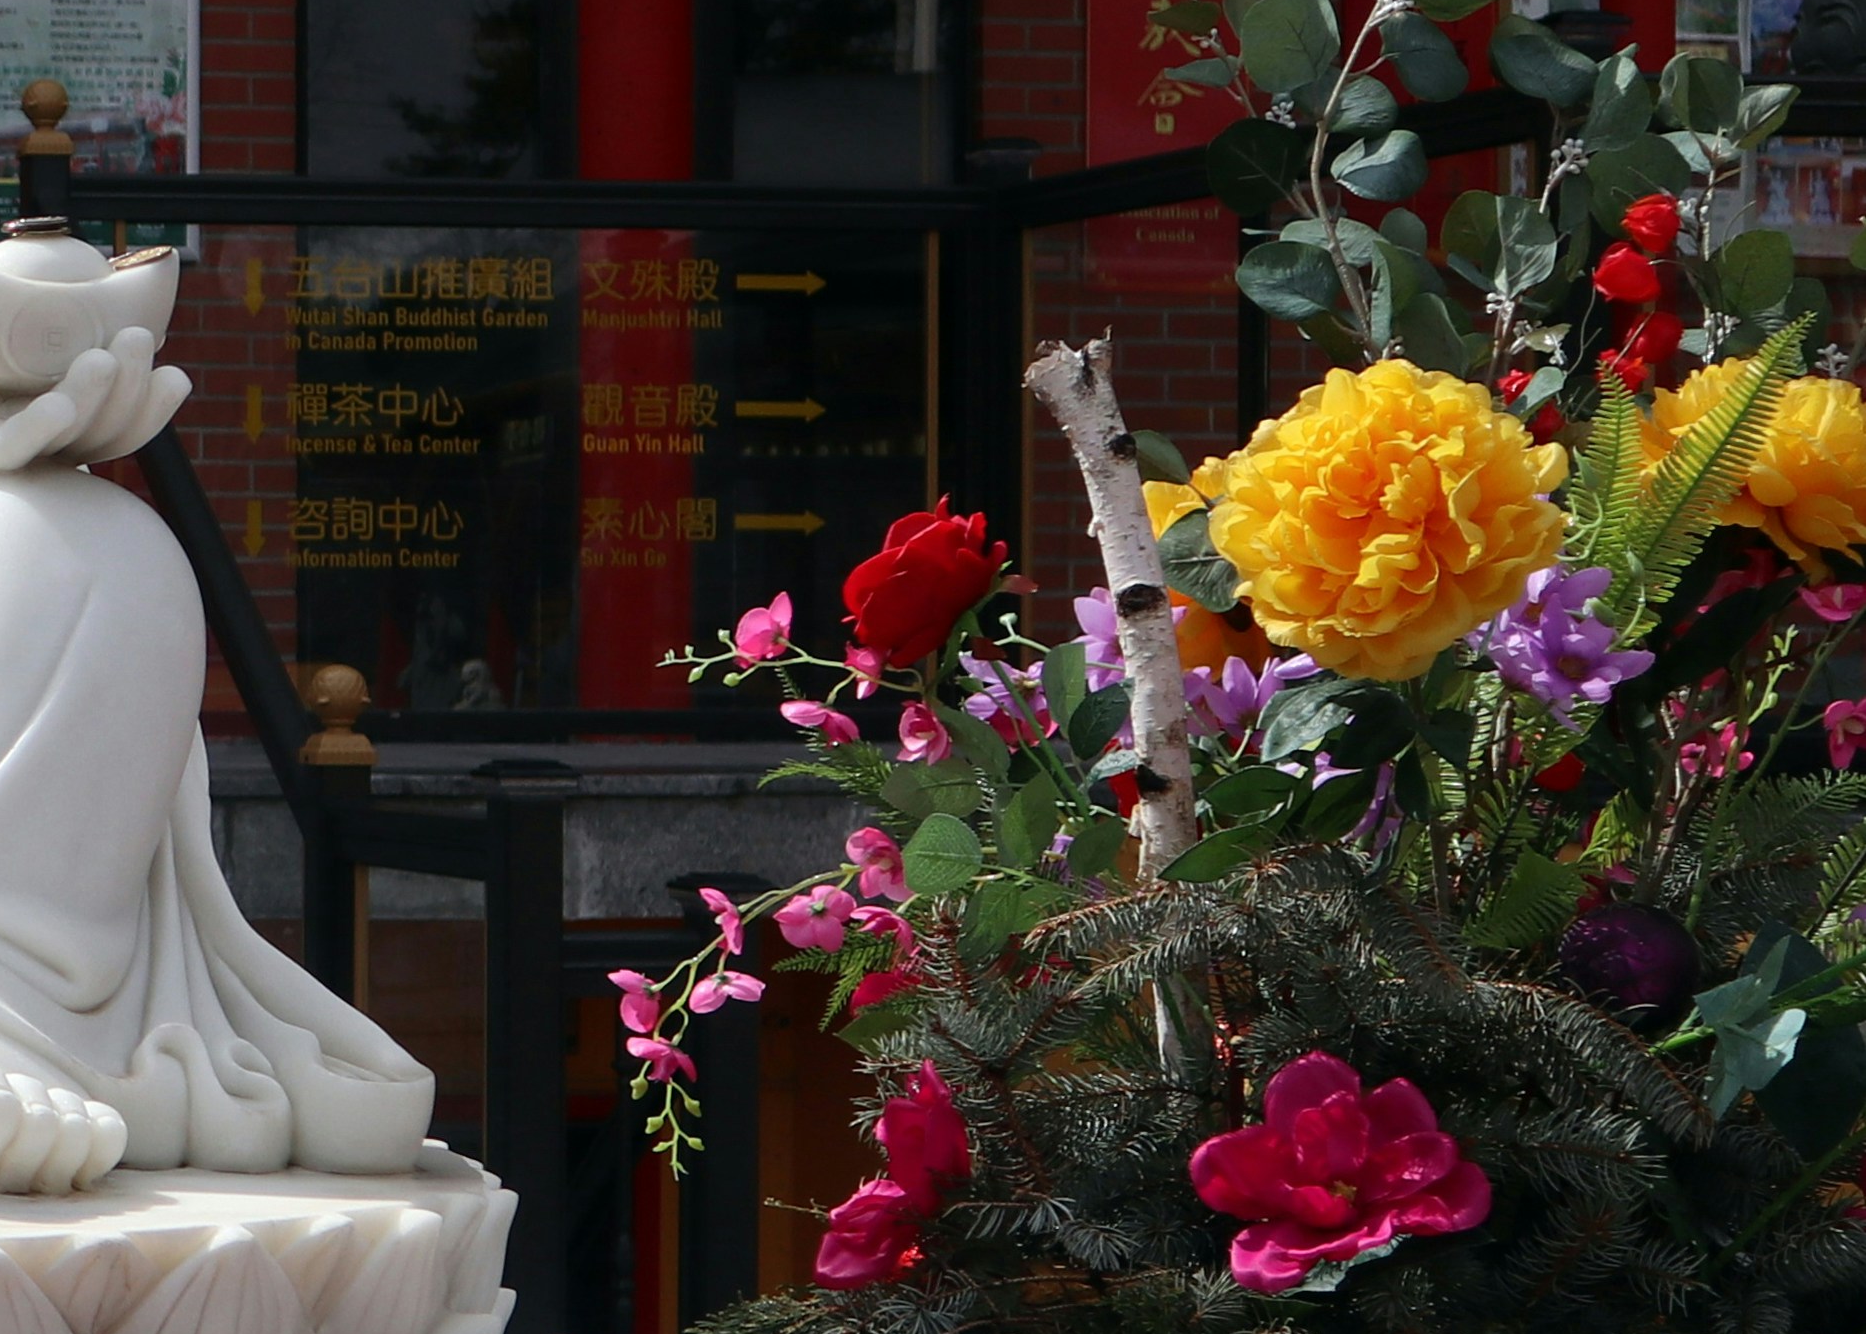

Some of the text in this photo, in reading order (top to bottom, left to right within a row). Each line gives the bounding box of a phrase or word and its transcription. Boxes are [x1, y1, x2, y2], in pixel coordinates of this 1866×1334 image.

[1134, 225, 1196, 244] Canada
[285, 257, 555, 302] 五台山推廣組
[583, 258, 721, 304] 文殊殿
[285, 308, 549, 328] Wutai Shan Buddhist Garden
[687, 309, 724, 331] Hall
[285, 331, 479, 353] in Canada Promotion
[285, 383, 464, 429] 禪茶中心
[583, 383, 719, 429] 觀音殿
[285, 433, 482, 455] Incense & Tea Center
[583, 433, 706, 455] Guan Yin Hall
[285, 497, 464, 543] 咨詢中心
[583, 497, 719, 543] 素心閣
[285, 547, 460, 569] Information Center
[583, 547, 667, 569] Su Xin Ge
